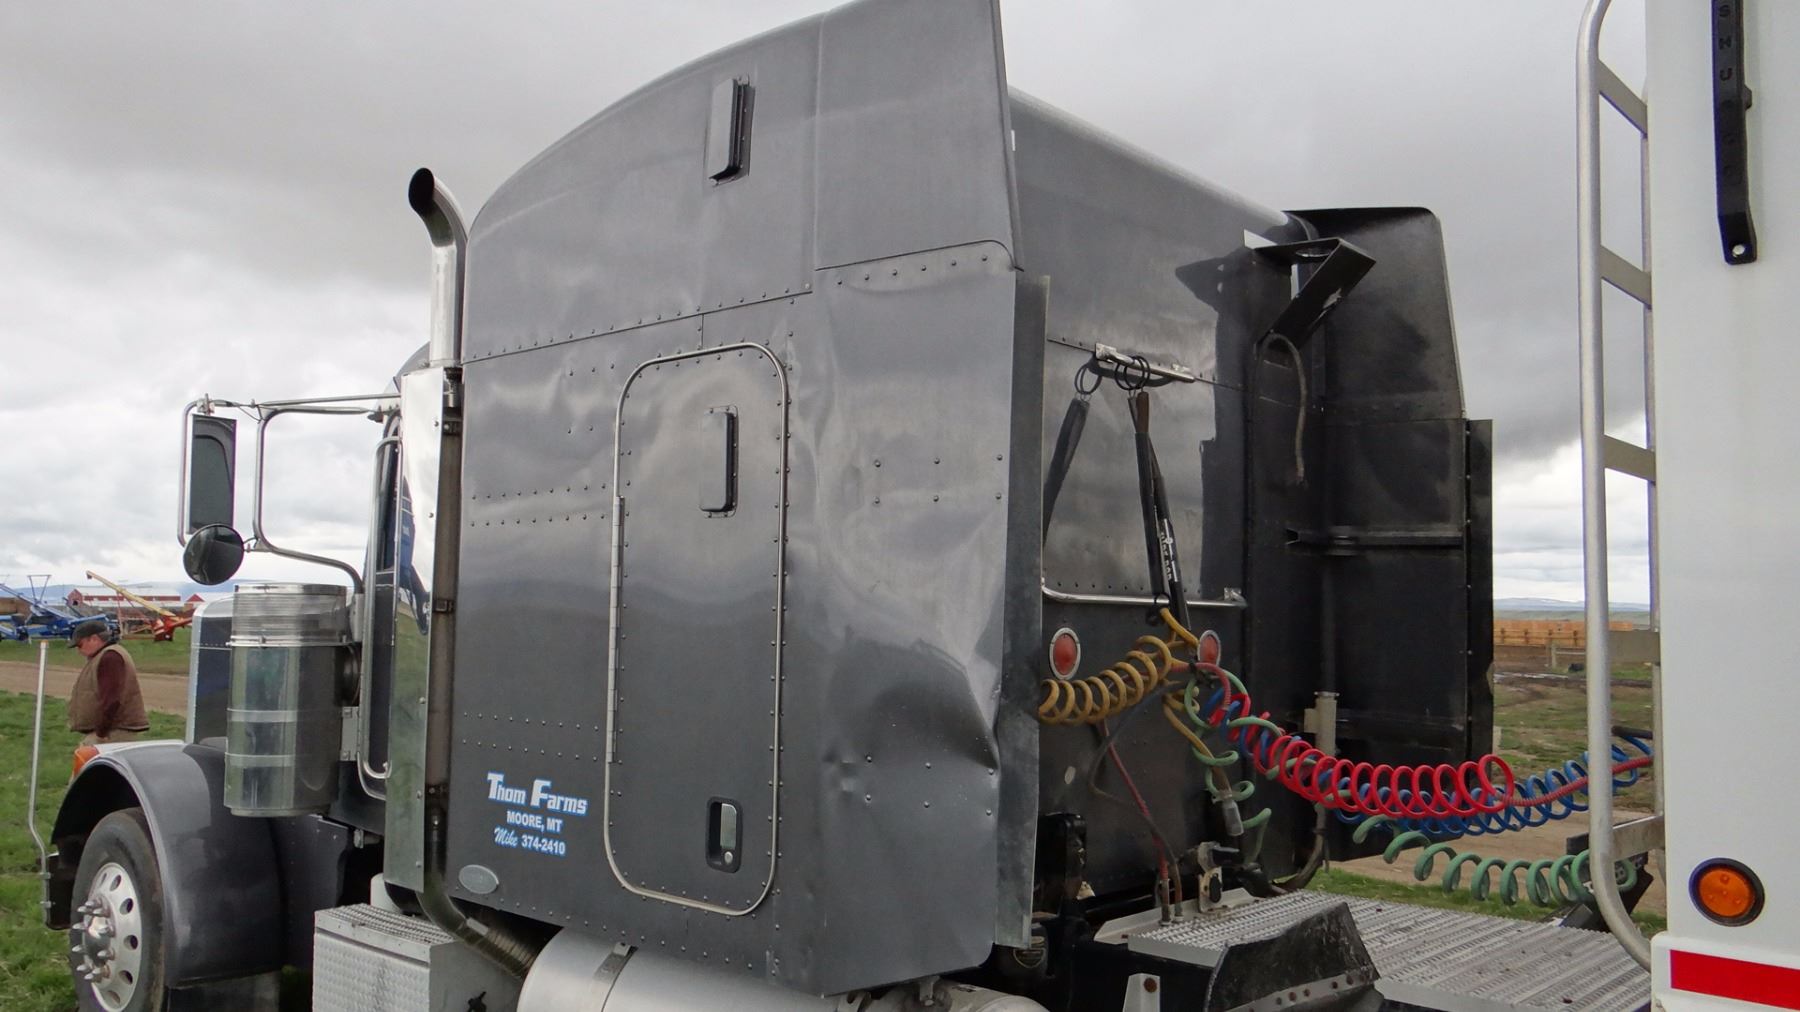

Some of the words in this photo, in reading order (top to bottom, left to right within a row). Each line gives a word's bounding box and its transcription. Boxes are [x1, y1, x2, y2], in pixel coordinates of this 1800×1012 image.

[486, 771, 527, 806] Thom
[529, 778, 588, 815] Farms
[506, 811, 545, 831] MOORE,
[546, 817, 563, 833] MT
[493, 826, 519, 847] Mike
[521, 835, 566, 855] 374-2410
